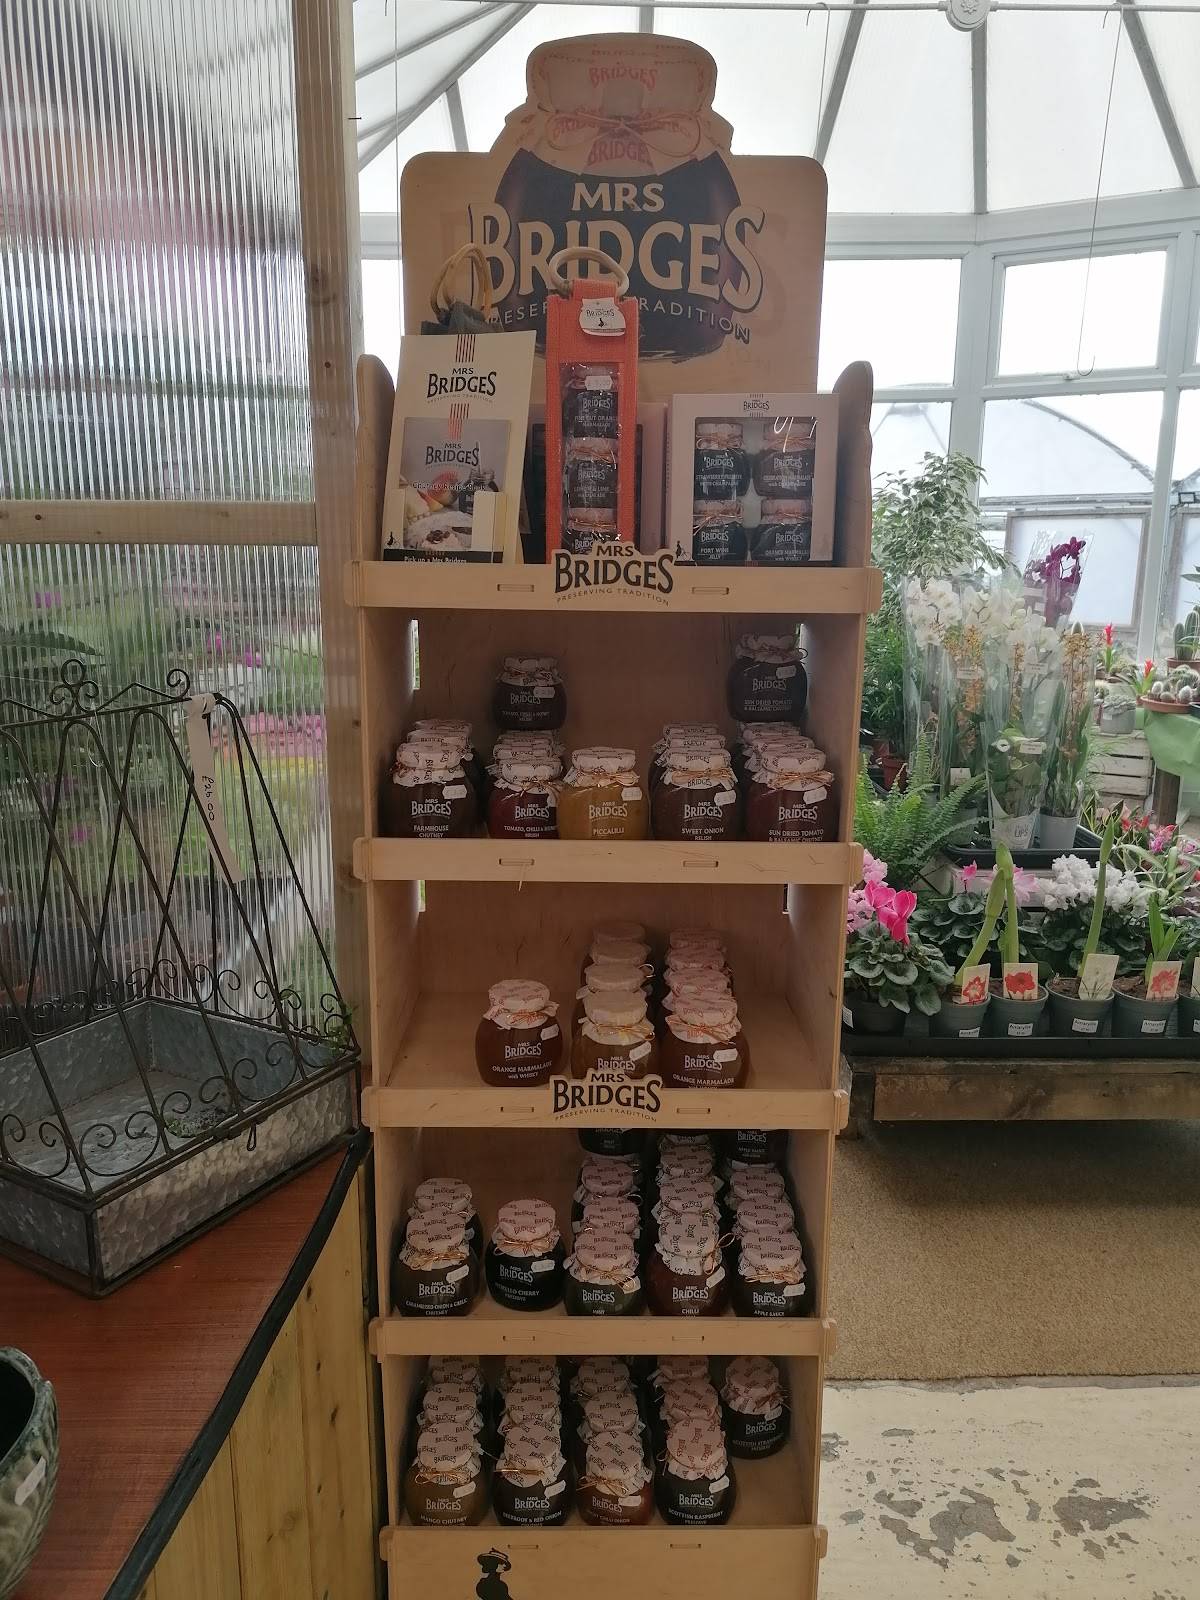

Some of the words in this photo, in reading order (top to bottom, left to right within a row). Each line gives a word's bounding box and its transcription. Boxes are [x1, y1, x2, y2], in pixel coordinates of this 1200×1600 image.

[571, 183, 665, 212] MRS
[468, 203, 766, 313] BRIDGES
[638, 297, 750, 344] RADITION
[452, 367, 474, 375] MRS
[426, 371, 497, 399] BRIDGES
[743, 401, 770, 411] BRIDGES
[425, 445, 480, 467] BRIDGES
[705, 456, 734, 468] BRIDGES
[774, 457, 803, 469] BRIDGES
[701, 531, 729, 543] BRIDGES
[775, 532, 804, 544] BRIDGES
[596, 545, 634, 557] MRS
[555, 552, 674, 594] BRIDGES
[557, 587, 613, 603] PRESERVING
[617, 588, 670, 607] TRADITION
[752, 678, 787, 692] BRIDGES
[510, 692, 541, 705] BRIDGES
[411, 800, 452, 816] BRIDGES
[514, 805, 550, 819] BRIDGES
[588, 803, 629, 819] BRIDGES
[683, 803, 723, 819] BRIDGES
[778, 806, 818, 821] BRIDGES
[413, 824, 449, 832] FARMHOUSE
[703, 826, 724, 835] ONION
[801, 828, 824, 836] TOMATO
[505, 1042, 542, 1059] BRIDGES
[492, 1065, 517, 1073] ORANGE
[517, 1060, 553, 1073] MARMALADE
[597, 1057, 636, 1072] BRIDGES
[684, 1055, 723, 1071] BRIDGES
[590, 1073, 624, 1083] MRS
[672, 1073, 696, 1084] ORANGE
[696, 1077, 735, 1085] MARMALADE
[553, 1079, 662, 1114] BRIDGES
[554, 1107, 606, 1121] PRESERVING
[610, 1108, 657, 1122] TRADITION
[737, 1130, 767, 1144] BRIDGES
[499, 1264, 534, 1283] BRIDGES
[418, 1281, 456, 1297] BRIDGES
[582, 1289, 615, 1303] BRIDGES
[672, 1286, 709, 1301] BRIDGES
[752, 1291, 787, 1305] BRIDGES
[745, 1423, 777, 1435] BRIDGES
[426, 1498, 462, 1511] BRIDGES
[514, 1497, 550, 1510] BRIDGES
[592, 1495, 623, 1513] BRIDGES
[678, 1493, 715, 1507] BRIDGES
